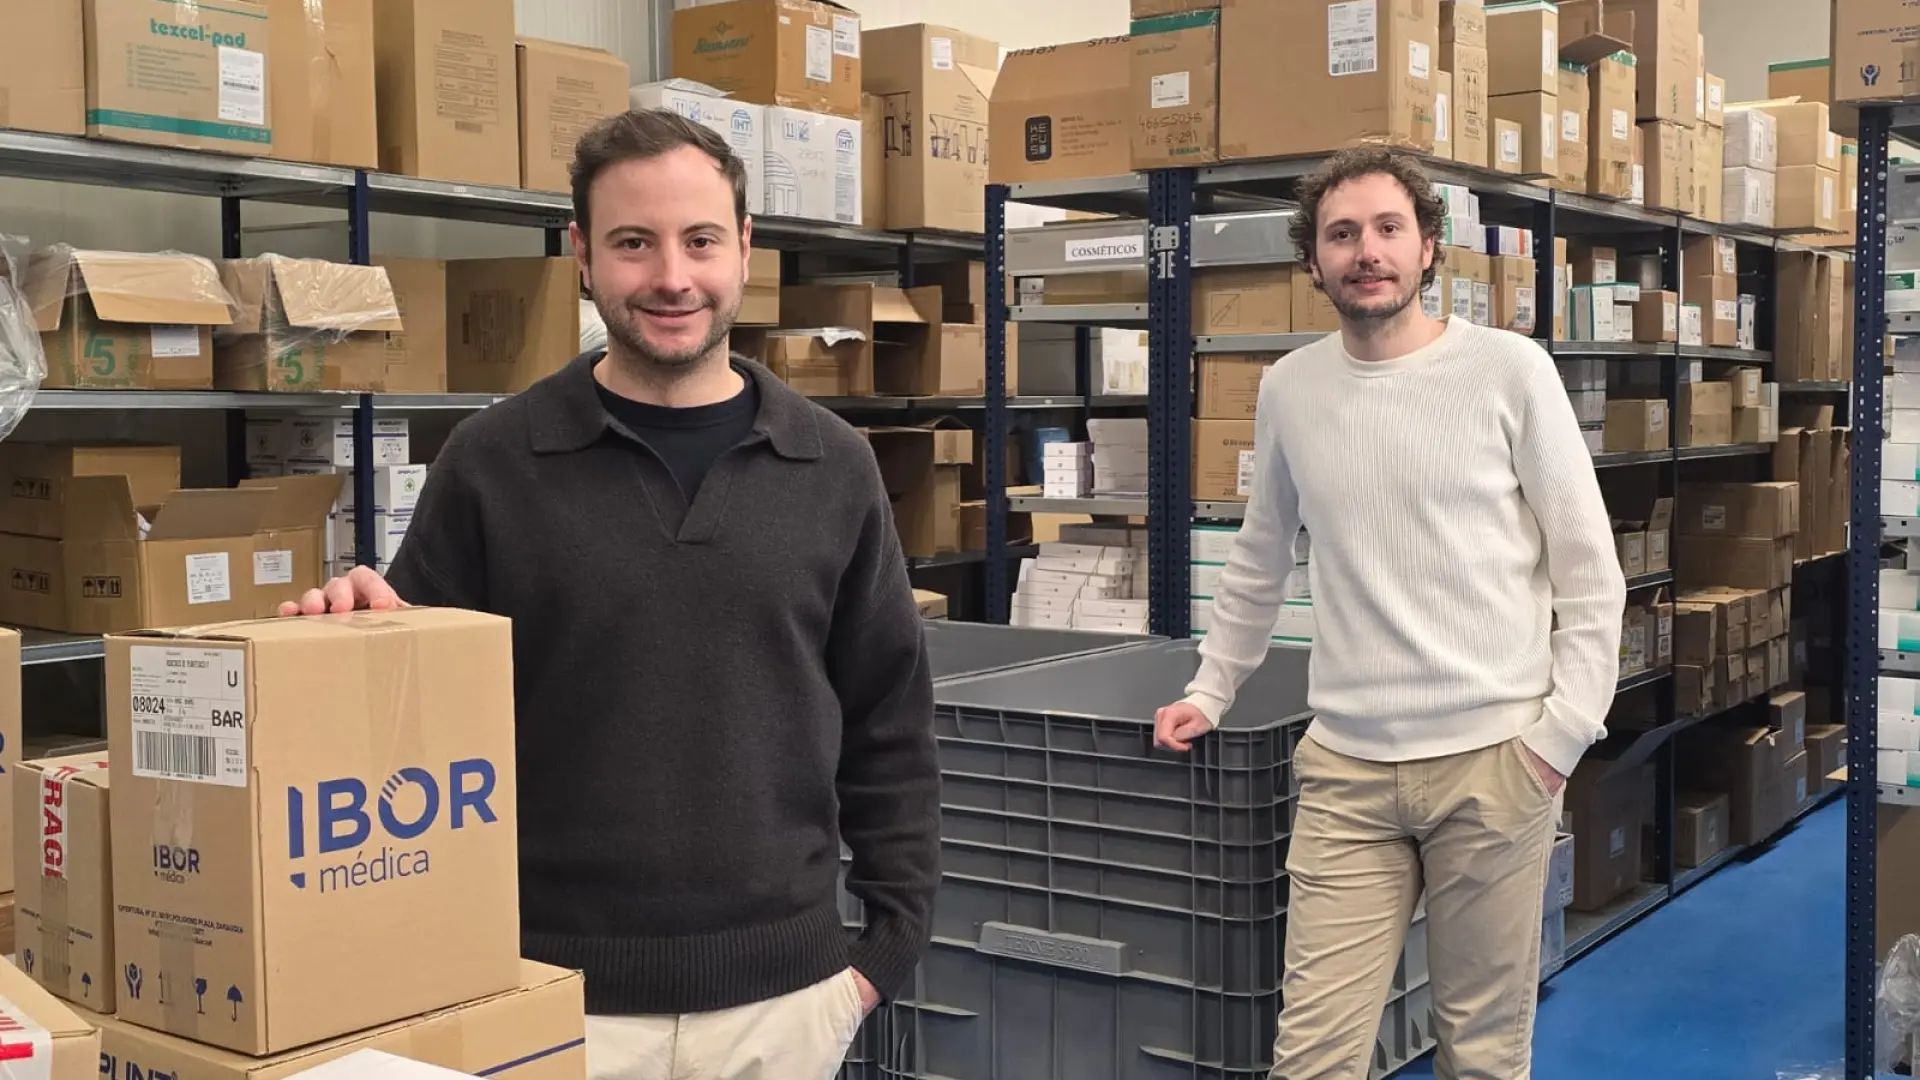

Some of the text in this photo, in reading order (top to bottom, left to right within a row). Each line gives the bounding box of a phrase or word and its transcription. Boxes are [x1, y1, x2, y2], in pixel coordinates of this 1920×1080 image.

[150, 18, 246, 48] texcel-pad
[1071, 244, 1137, 257] COSMÉTICOS
[227, 670, 238, 688] U
[132, 696, 165, 714] 08024
[211, 709, 243, 728] BAR
[287, 758, 498, 859] IBOR
[153, 844, 200, 874] IBOR
[320, 846, 430, 893] médica
